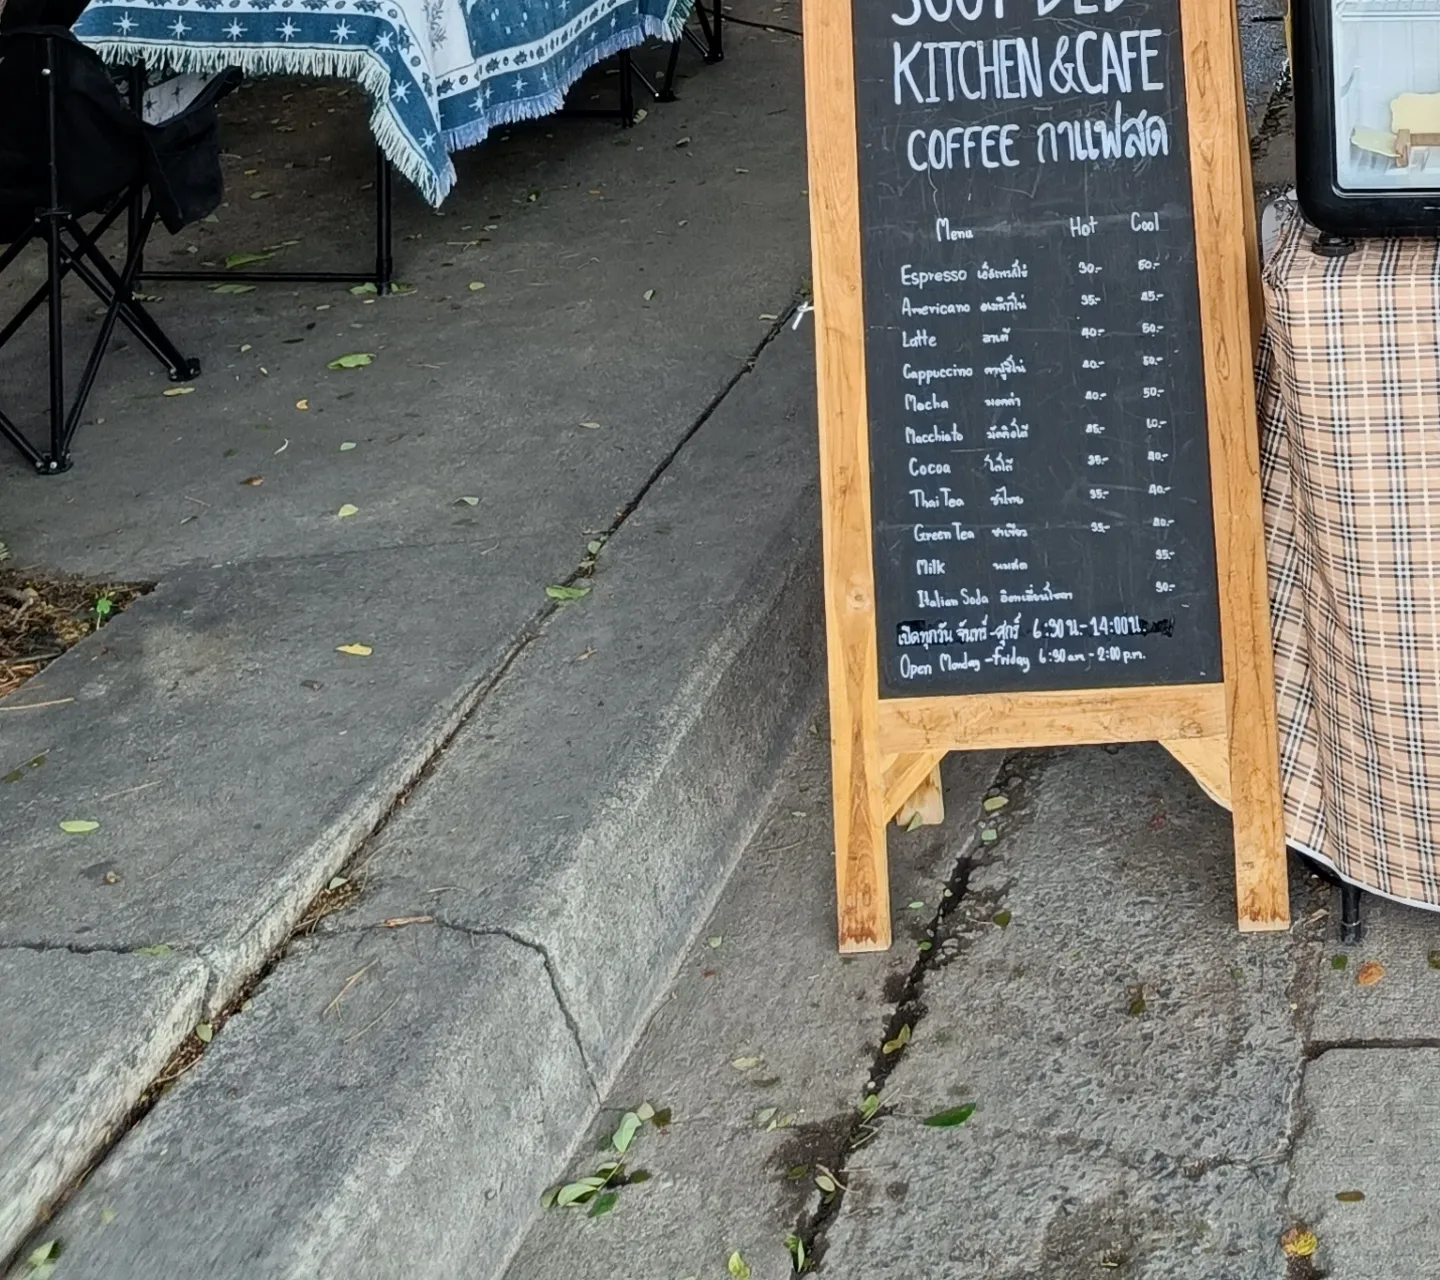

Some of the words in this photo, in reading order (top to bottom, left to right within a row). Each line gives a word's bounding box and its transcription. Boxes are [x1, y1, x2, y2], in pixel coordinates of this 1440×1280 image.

[894, 37, 1042, 104] KITCHEN
[908, 124, 1019, 171] COFFEE
[1037, 100, 1168, 163] กาแฟสด
[936, 218, 973, 241] Menu
[1070, 216, 1098, 237] Hot
[1131, 212, 1159, 231] Cool
[901, 265, 967, 289] Espresso
[902, 297, 970, 316] Americano
[903, 329, 936, 347] Latte
[903, 364, 973, 385] Cappuccino
[905, 393, 948, 411] Mocha
[906, 423, 963, 444] Macchiato
[909, 457, 951, 476] Cocoa
[909, 489, 939, 508] Thai
[940, 488, 964, 507] Tea
[914, 524, 951, 541] Green
[952, 522, 974, 540] Tea
[917, 559, 945, 575] Milk
[917, 590, 958, 608] Italian
[961, 588, 988, 605] Soda
[900, 654, 932, 679] Open
[940, 652, 980, 672] Monday
